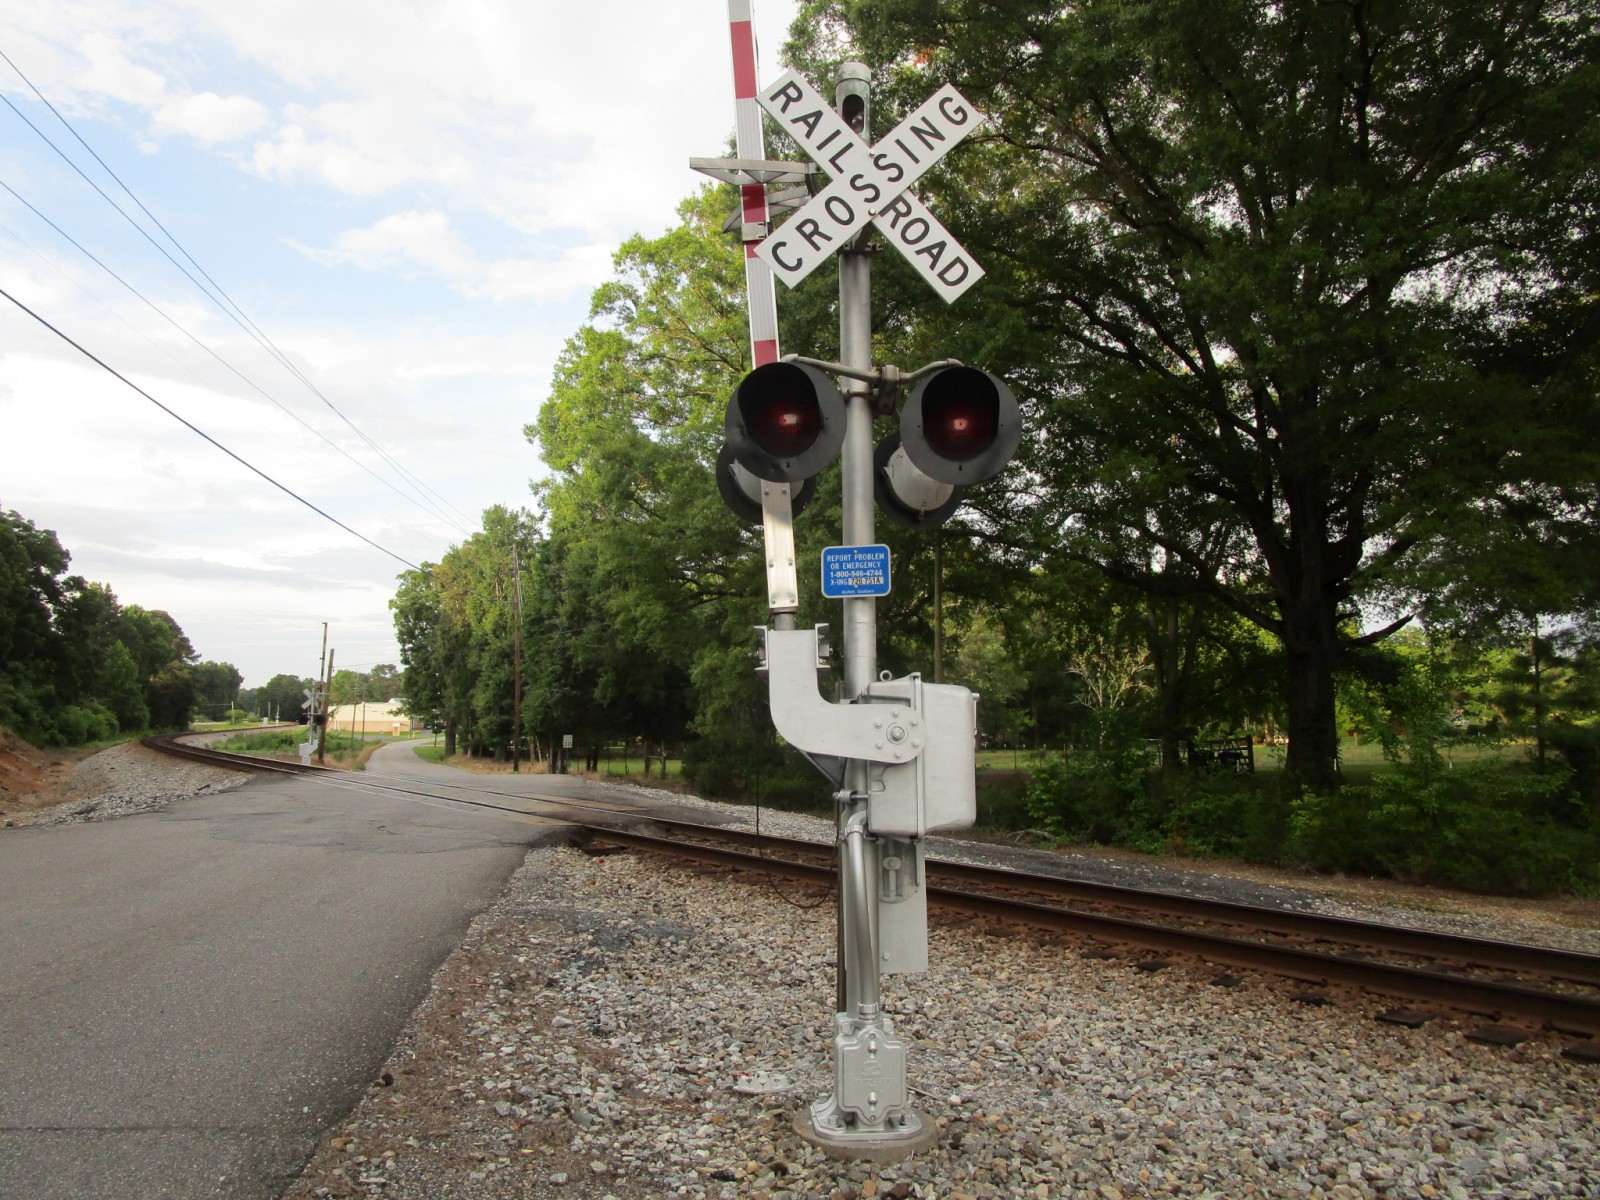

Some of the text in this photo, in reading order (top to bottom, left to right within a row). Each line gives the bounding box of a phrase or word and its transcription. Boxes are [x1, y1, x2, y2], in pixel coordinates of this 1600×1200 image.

[769, 80, 969, 287] RAIL ROAD
[771, 96, 968, 272] CROSSING
[826, 553, 885, 562] REPORT PROBLEM
[830, 561, 881, 570] OR EMERGENCY
[830, 569, 882, 578] 1-800-946-4744
[830, 578, 848, 586] X-ING
